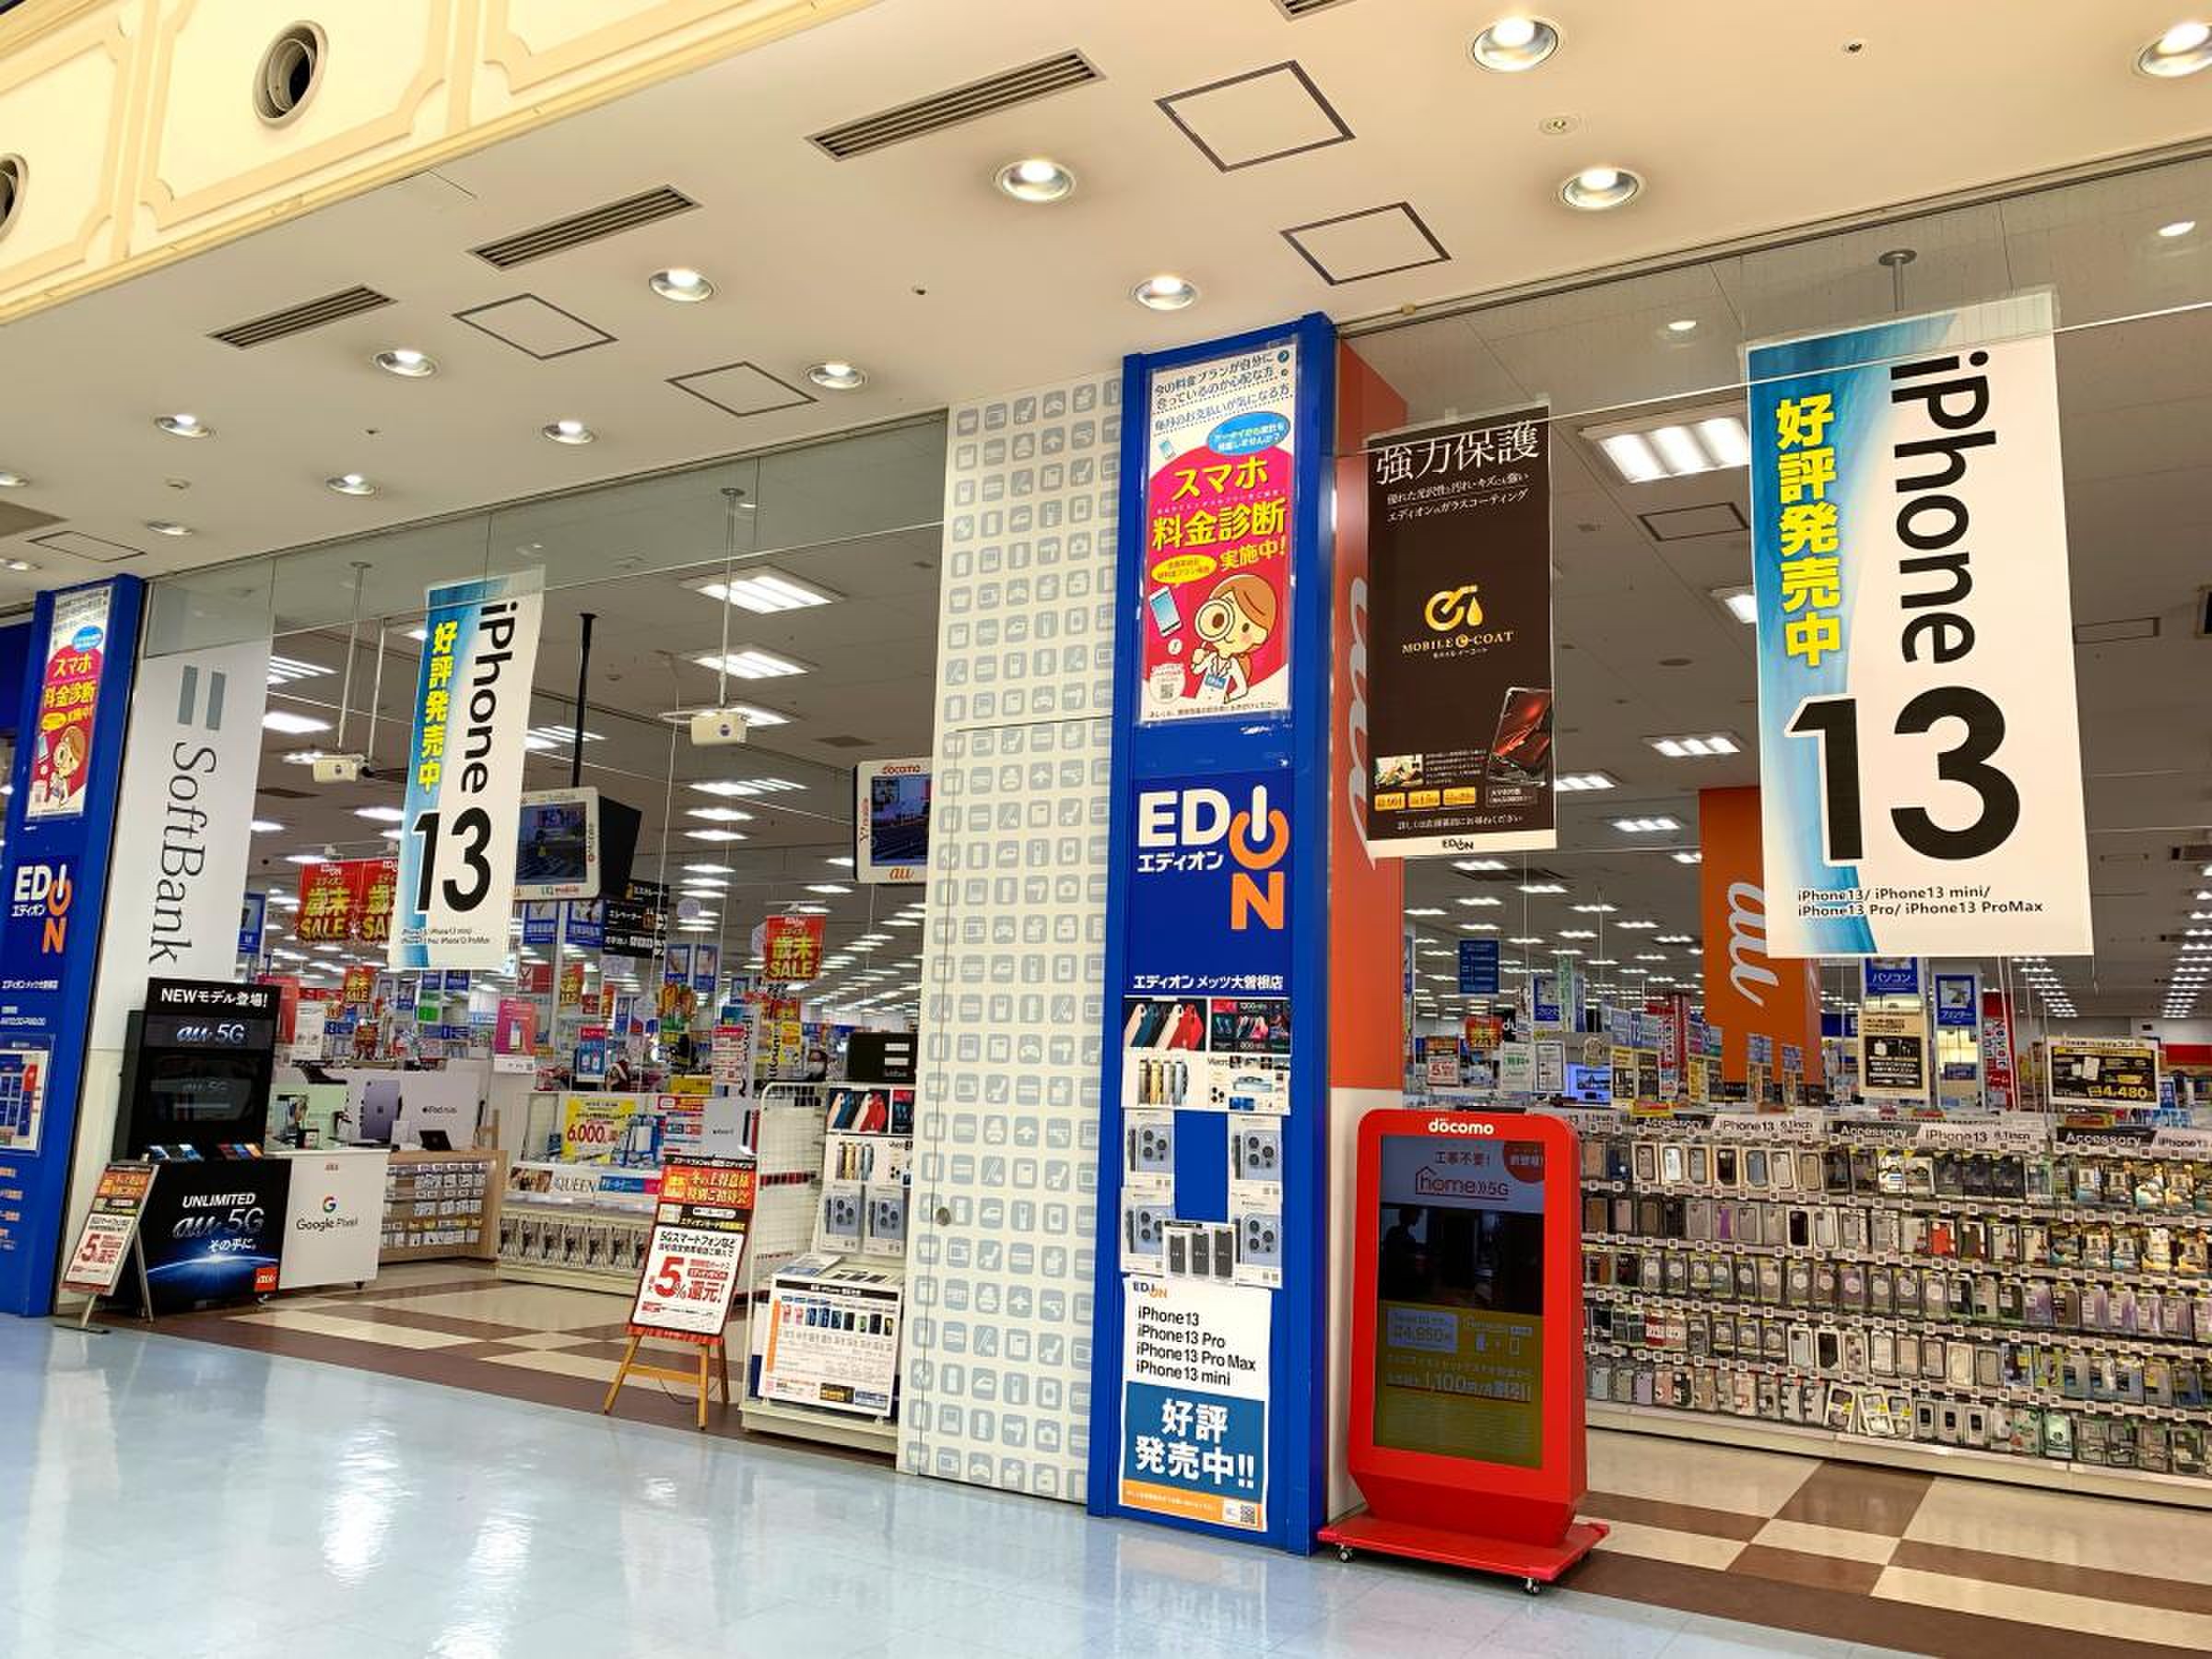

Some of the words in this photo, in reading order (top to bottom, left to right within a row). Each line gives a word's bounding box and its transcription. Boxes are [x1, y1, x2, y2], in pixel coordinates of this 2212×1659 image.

[1375, 419, 1540, 486] 強力保護
[1171, 455, 1268, 502] スマホ
[1890, 349, 1997, 665] iPhone
[1152, 497, 1288, 550] 料金診断
[1774, 392, 1841, 667] 好評発売中
[1219, 535, 1286, 571] 実施中!
[53, 655, 93, 677] スマホ
[42, 683, 96, 708] 料金診断
[417, 620, 458, 793] 好評発売中
[460, 601, 518, 794] iPhone
[1788, 685, 2021, 862] 13
[148, 741, 217, 964] SoftBank
[411, 806, 492, 913] 13
[1136, 851, 1224, 873] エディオン
[304, 886, 350, 915] 歳末
[1875, 887, 1945, 900] iPhone13
[1798, 904, 1865, 917] iPhone13
[1869, 902, 1901, 916] Pro/
[1905, 902, 1976, 915] iPhone13
[1982, 900, 2044, 914] ProMax
[299, 916, 347, 940] SALE
[770, 960, 813, 977] SALE
[1133, 974, 1194, 990] エディオン
[160, 987, 268, 1008] NEWモデル登場!
[217, 1023, 245, 1044] 5G
[1428, 1117, 1495, 1135] docomo
[182, 1192, 256, 1208] UNLIMITED
[227, 1207, 265, 1233] 5G
[296, 1218, 335, 1232] Google
[207, 1236, 257, 1253] その手に。
[1137, 1305, 1184, 1325] iPhone
[1185, 1312, 1199, 1326] 13
[1136, 1324, 1183, 1344] iPhone
[1185, 1330, 1199, 1345] 13
[1202, 1332, 1227, 1349] Pro
[1136, 1342, 1183, 1361] iPhone
[1185, 1348, 1199, 1363] 13
[1201, 1350, 1226, 1368] Pro
[1228, 1354, 1257, 1372] Max
[1136, 1359, 1182, 1381] iPhone
[1184, 1366, 1199, 1382] 13
[1201, 1369, 1231, 1387] mini
[1161, 1397, 1229, 1444] 好評
[1135, 1435, 1255, 1489] 発売中!!
